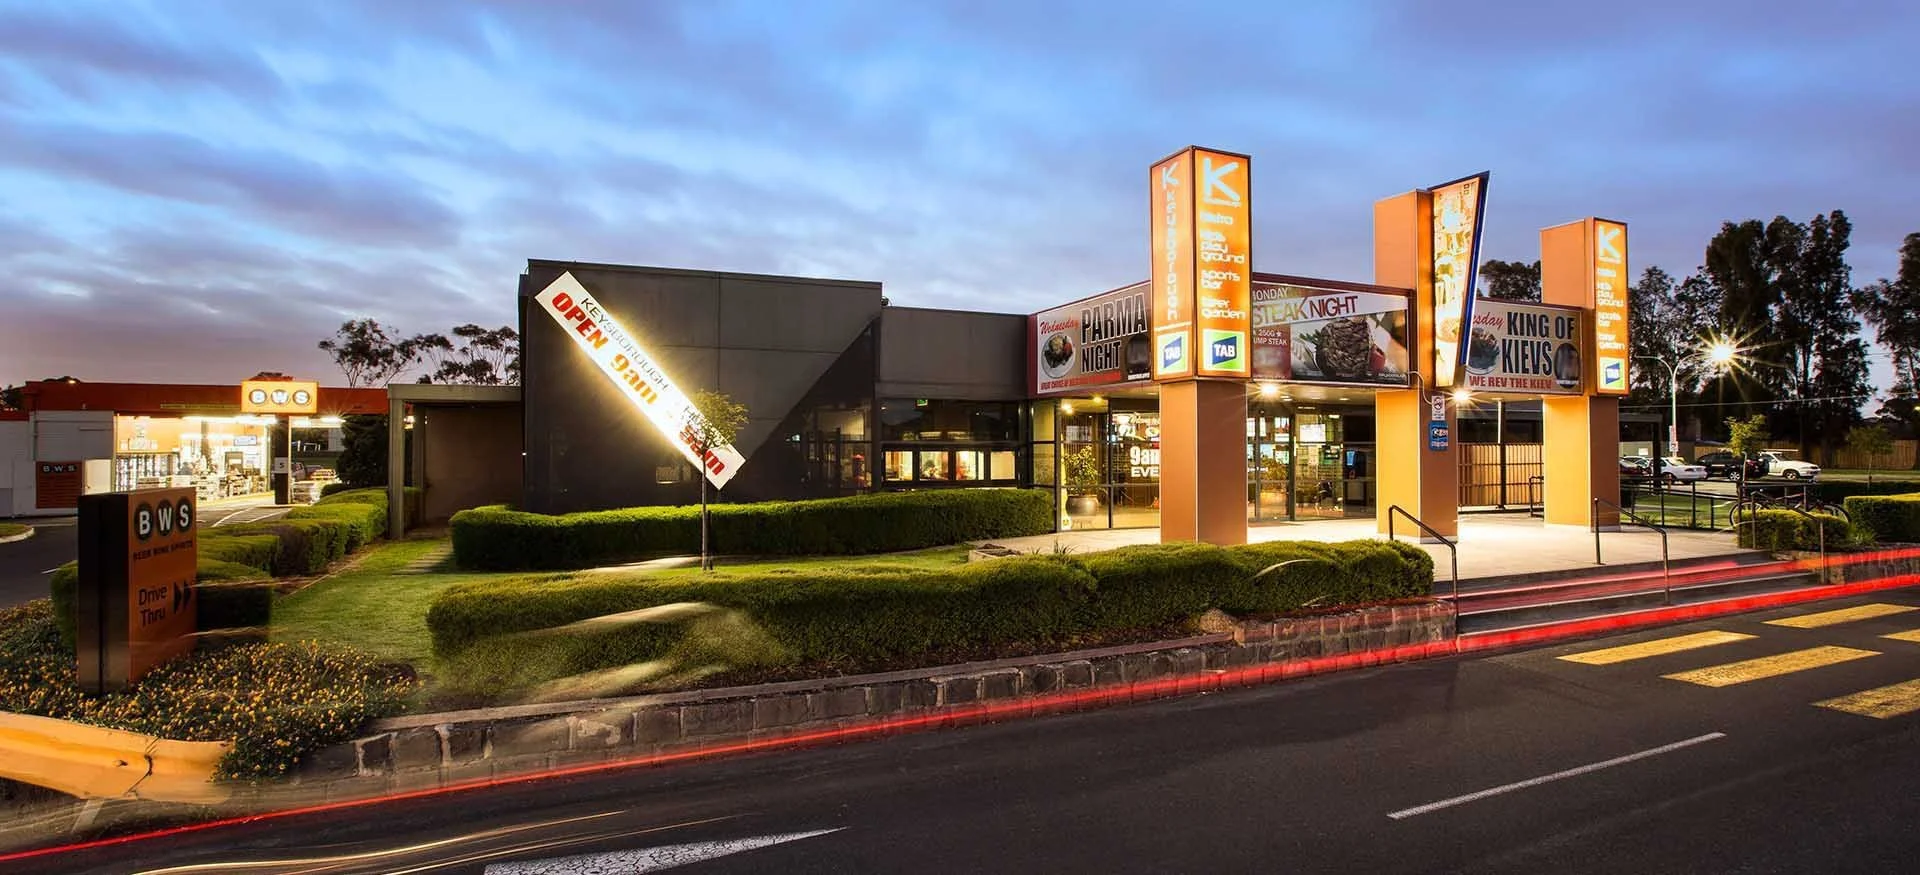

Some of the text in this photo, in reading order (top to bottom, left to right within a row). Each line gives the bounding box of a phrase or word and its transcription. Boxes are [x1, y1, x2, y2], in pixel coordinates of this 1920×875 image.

[1162, 162, 1179, 189] K
[1203, 158, 1239, 201] K
[1599, 225, 1621, 258] K
[1253, 287, 1289, 301] ONDAY
[551, 292, 609, 350] OPEN
[1080, 292, 1148, 346] PARMA
[1253, 295, 1359, 326] STEAK NIGHT
[1507, 311, 1575, 340] KING OF
[1081, 340, 1121, 374] NIGHT
[1164, 346, 1181, 361] TAB
[1214, 344, 1237, 358] TAB
[1502, 338, 1553, 376] KIEVS
[610, 353, 658, 405] 9am
[1469, 375, 1486, 387] WE
[1488, 376, 1506, 388] REV
[1508, 377, 1528, 389] THE
[139, 585, 168, 606] Drive
[141, 607, 166, 627] Thru
